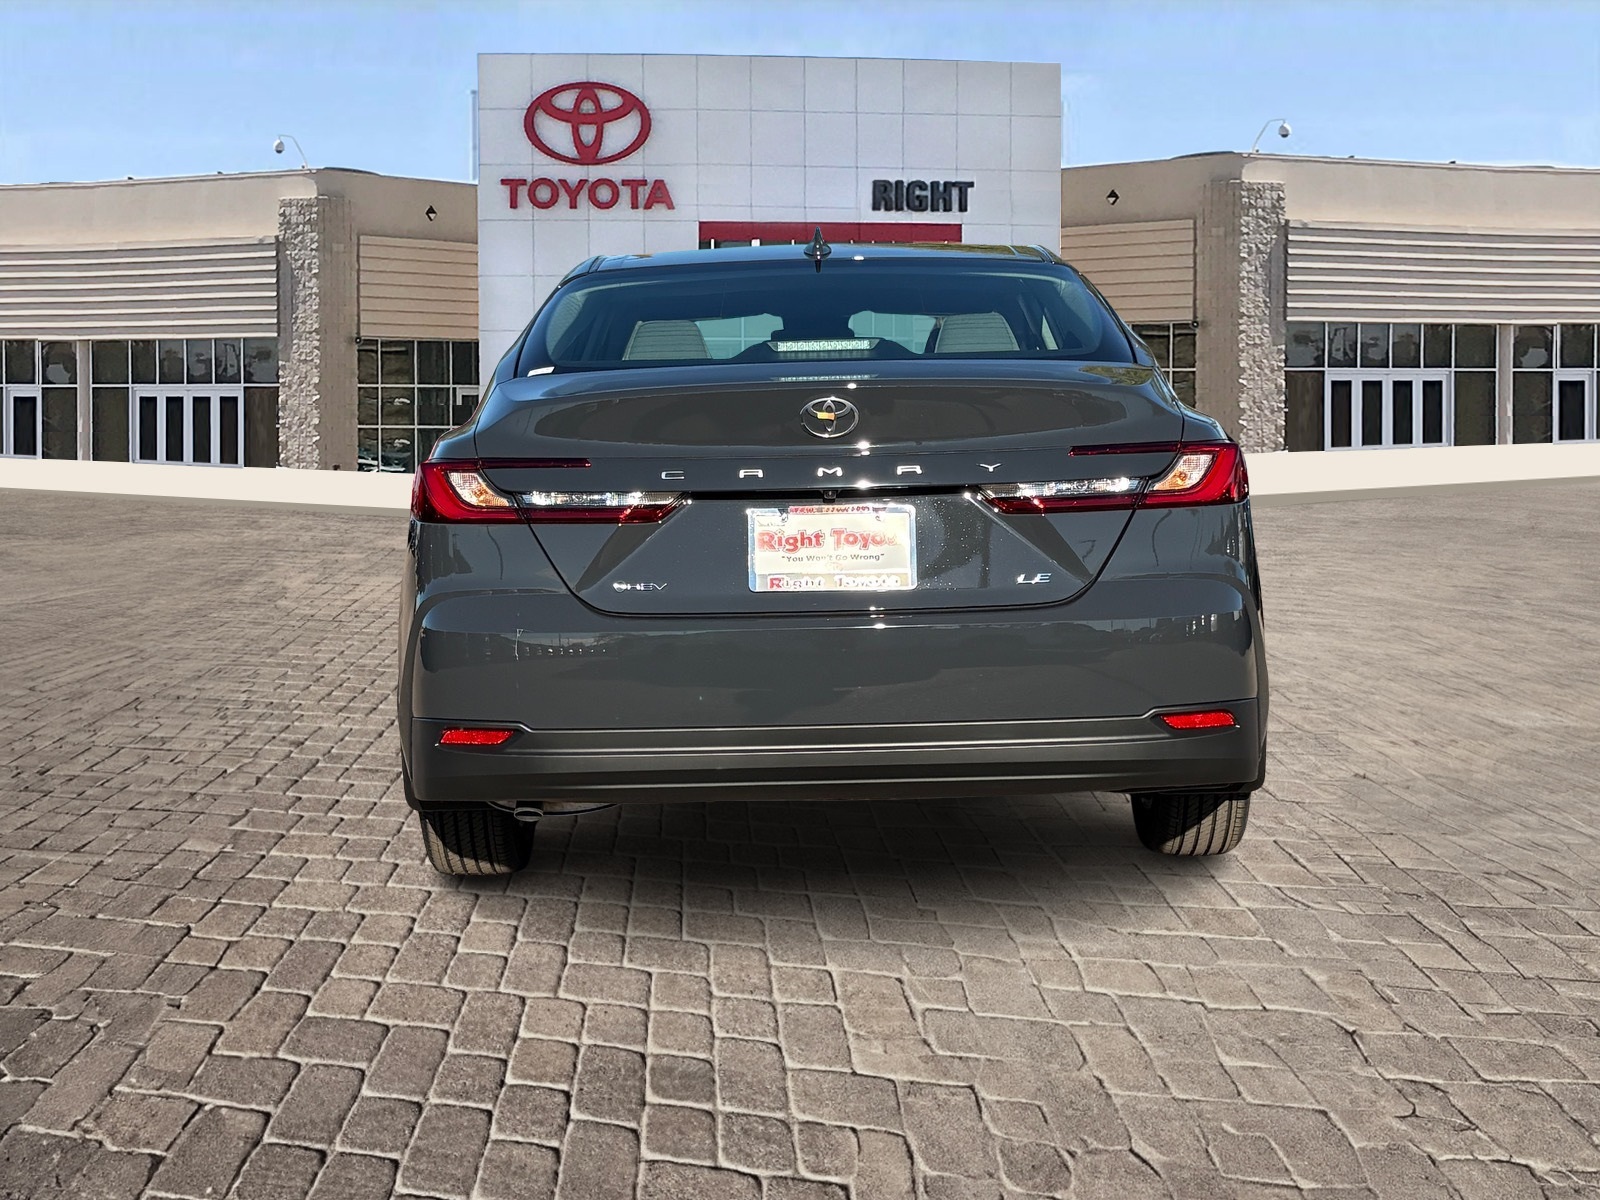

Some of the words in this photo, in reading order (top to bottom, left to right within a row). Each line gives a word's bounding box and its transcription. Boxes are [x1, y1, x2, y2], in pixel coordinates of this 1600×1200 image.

[501, 179, 675, 210] TOYOTA
[872, 179, 975, 212] RIGHT
[660, 463, 1001, 481] CAMRY
[757, 529, 825, 553] Right
[835, 552, 848, 562] Go
[1016, 573, 1052, 585] LE
